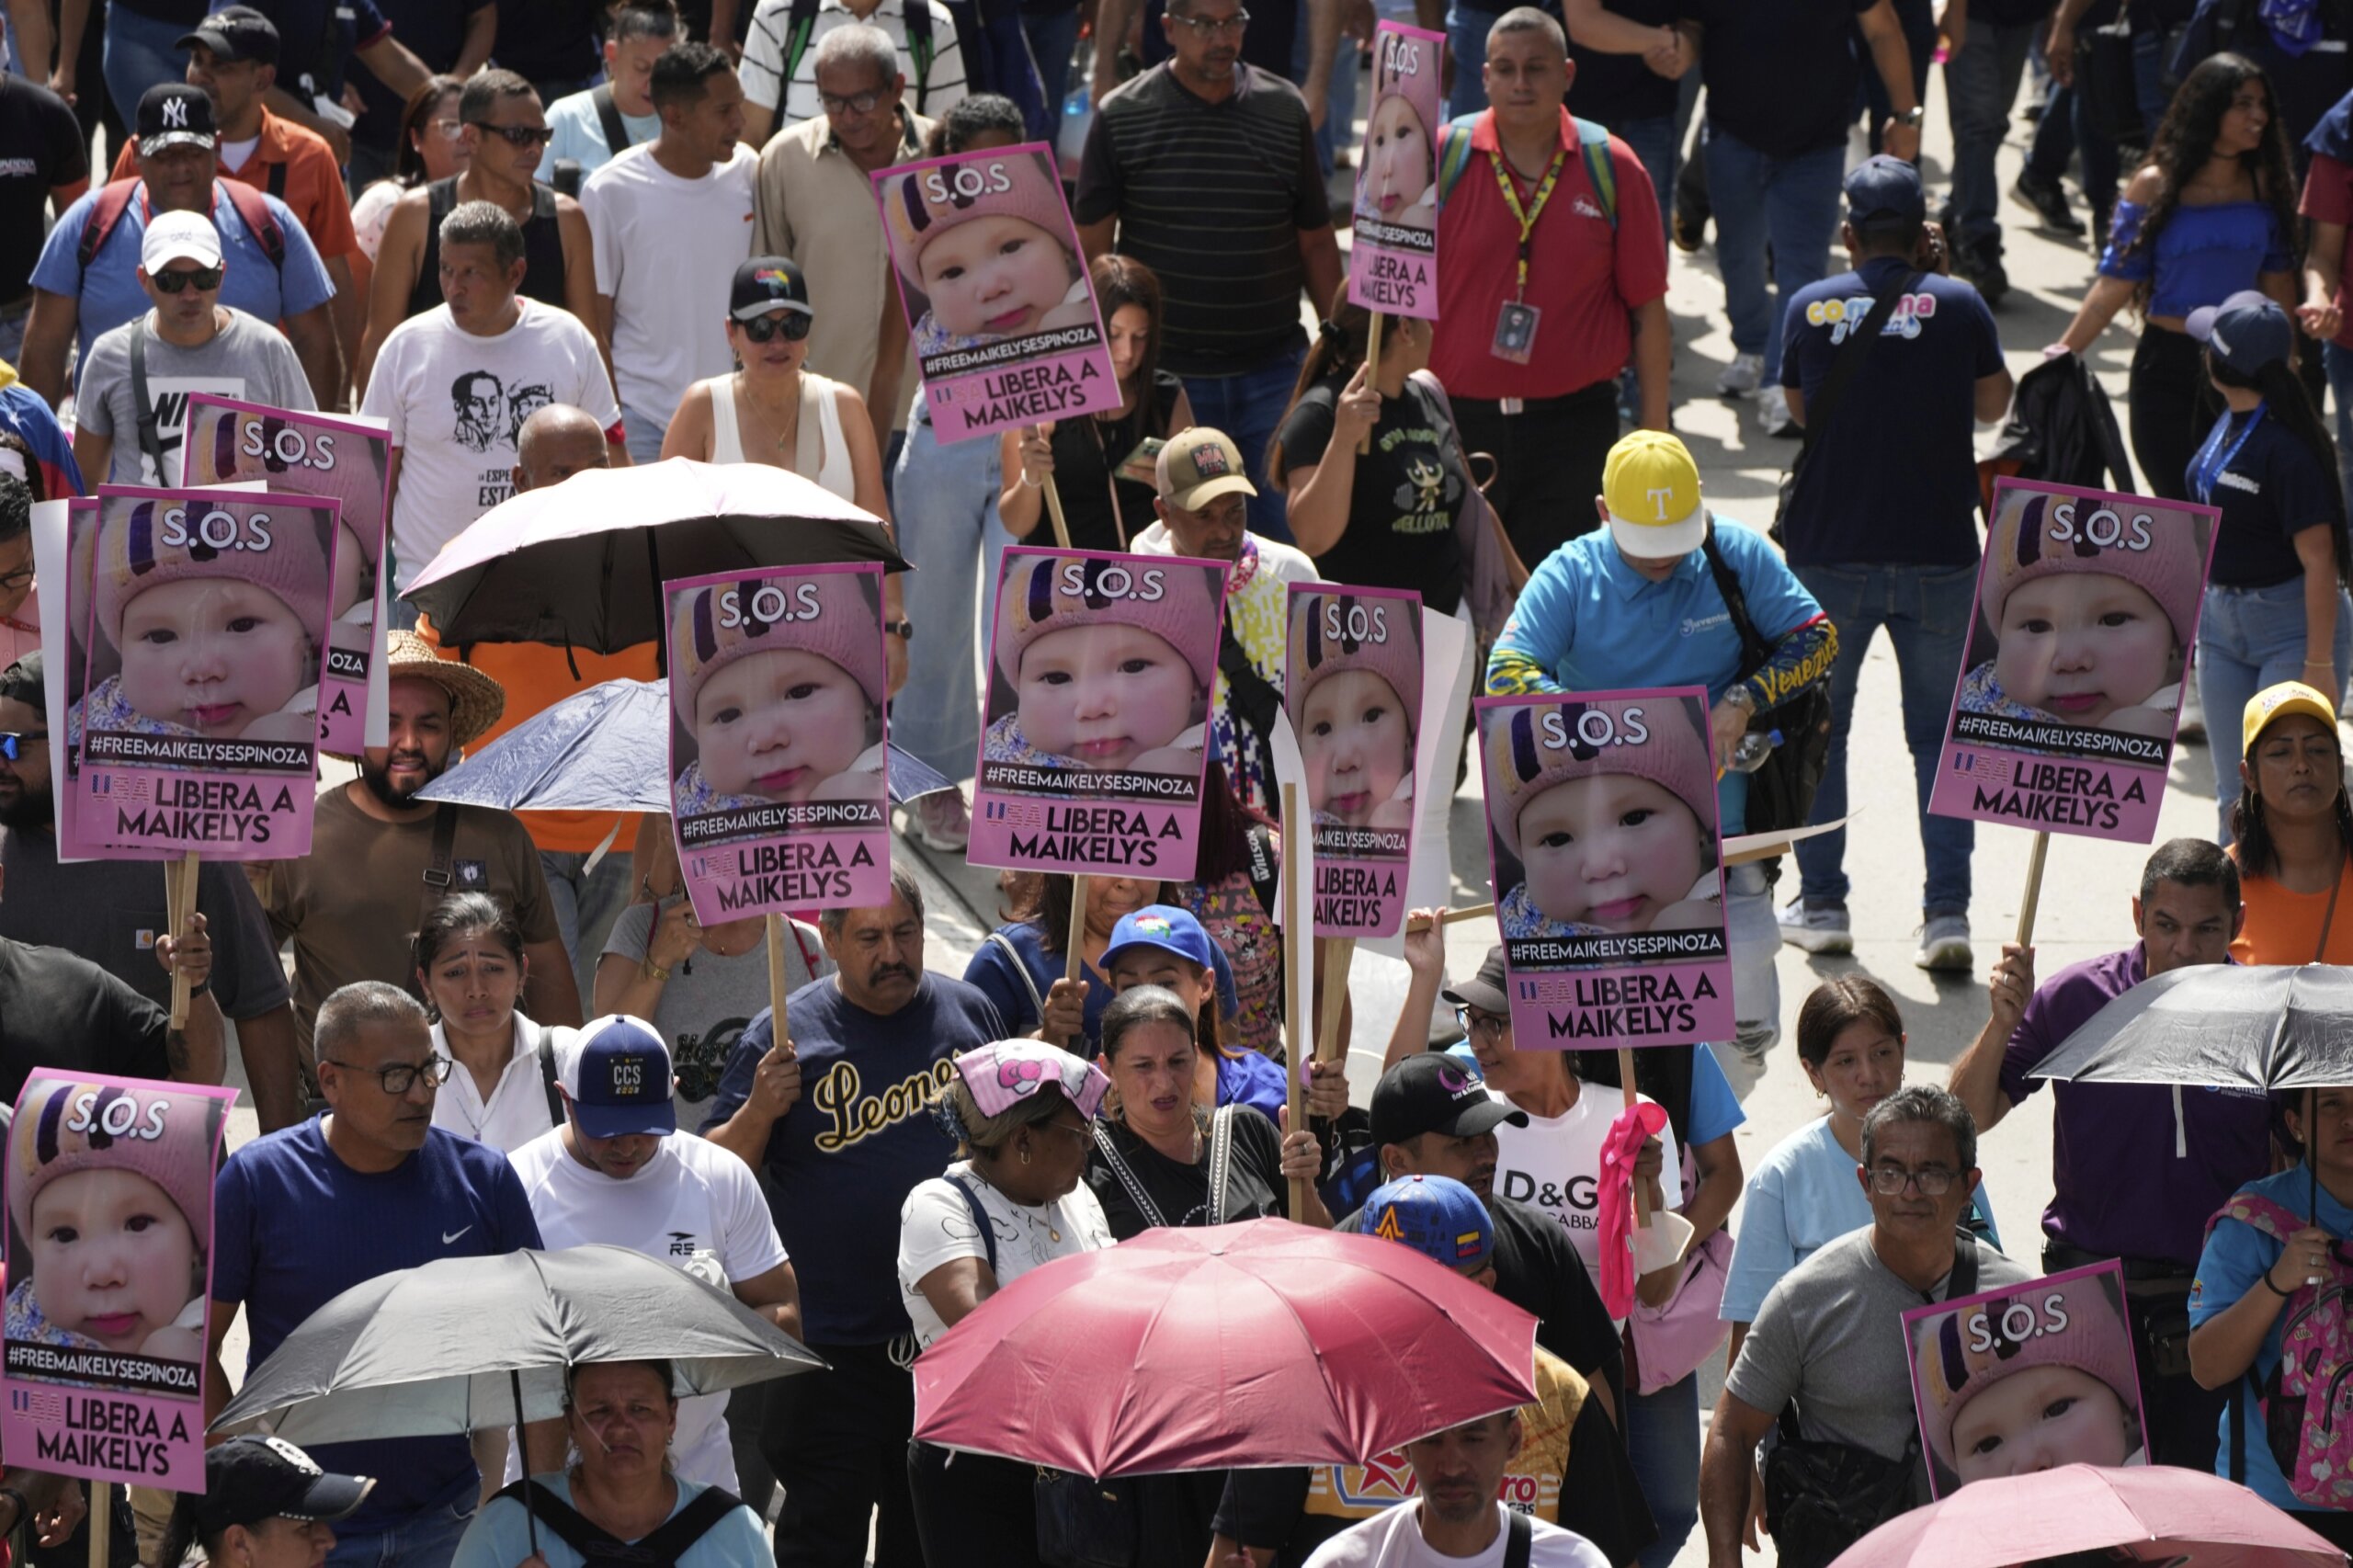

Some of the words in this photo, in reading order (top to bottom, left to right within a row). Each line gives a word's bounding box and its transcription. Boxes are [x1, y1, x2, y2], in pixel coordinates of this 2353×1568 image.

[1387, 40, 1419, 75] S.O.S
[163, 97, 188, 128] NY
[926, 164, 1011, 202] S.O.S
[1414, 261, 1428, 287] A
[1806, 294, 1937, 326] comna
[925, 327, 1098, 374] #FREEMAIKELYSESPINOZA
[984, 361, 1074, 399] LIBERA
[1080, 358, 1100, 381] A
[962, 383, 1086, 429] MAIKELYS
[242, 420, 335, 471] S.O.S
[1647, 488, 1674, 521] T
[161, 507, 272, 551] S.O.S
[2049, 504, 2154, 551] S.O.S
[1060, 563, 1165, 600] S.O.S
[720, 583, 820, 628] S.O.S
[1325, 602, 1387, 643] S.O.S
[1541, 707, 1648, 749] S.O.S
[1958, 717, 2164, 759] #FREEMAIKELYSESPINOZA
[90, 736, 309, 765] #FREEMAIKELYSESPINOZA
[154, 778, 264, 812] LIBERA
[270, 784, 296, 813] A
[985, 767, 1195, 796] #FREEMAIKELYSESPINOZA
[2013, 761, 2115, 800] LIBERA
[2121, 776, 2147, 804] A
[117, 806, 271, 843] MAIKELYS
[683, 804, 882, 839] #FREEMAIKELYSESPINOZA
[1046, 806, 1151, 837] LIBERA
[1157, 812, 1183, 840] A
[1972, 784, 2121, 830] MAIKELYS
[738, 841, 842, 877] LIBERA
[848, 839, 876, 868] A
[1009, 831, 1158, 867] MAIKELYS
[716, 870, 853, 913] MAIKELYS
[1315, 867, 1379, 897] LIBERA
[1381, 869, 1397, 898] A
[1511, 934, 1722, 960] #FREEMAIKELYSESPINOZA
[1575, 972, 1686, 1007] LIBERA
[1692, 971, 1719, 1000] A
[1547, 1004, 1697, 1039] MAIKELYS
[613, 1064, 642, 1085] CCS
[66, 1092, 171, 1140] S.O.S
[1968, 1293, 2068, 1353] S.O.S
[7, 1346, 198, 1389] #FREEMAIKELYSESPINOZA
[65, 1396, 162, 1439] LIBERA
[167, 1410, 190, 1443] A
[36, 1426, 170, 1477] MAIKELYS
